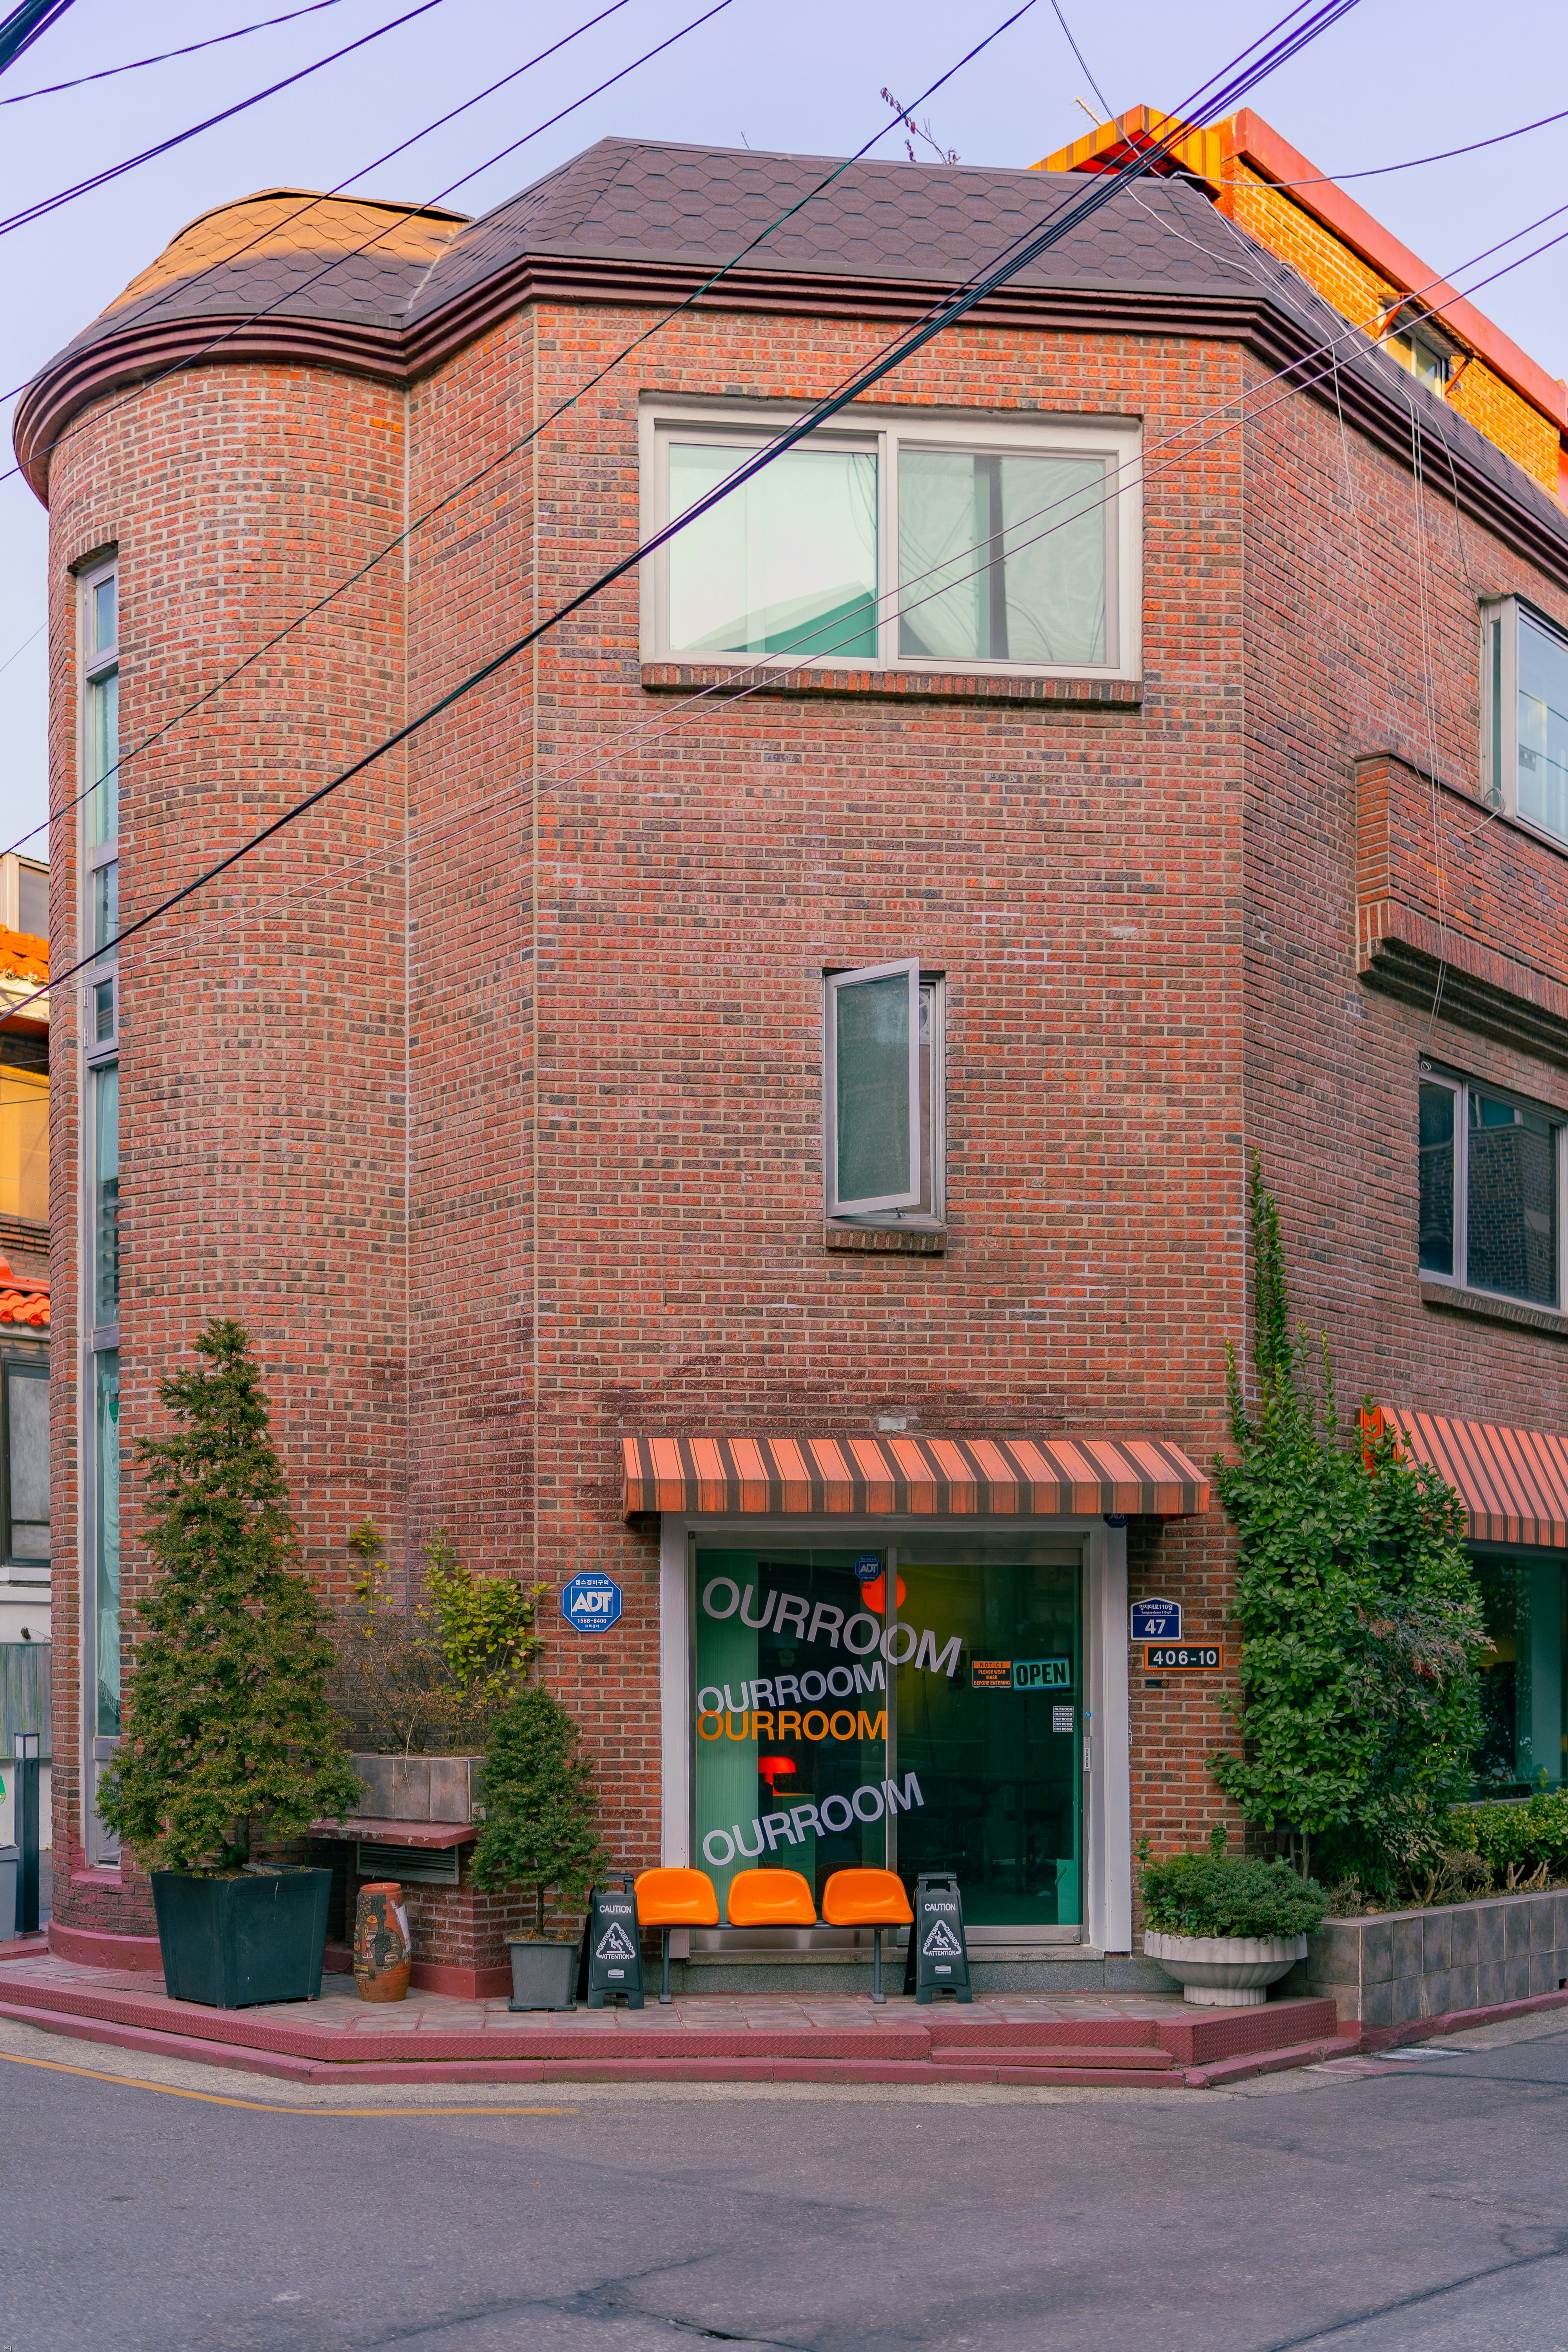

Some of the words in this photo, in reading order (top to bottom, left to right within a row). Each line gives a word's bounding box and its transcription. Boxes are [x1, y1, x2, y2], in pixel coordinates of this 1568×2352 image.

[860, 1564, 878, 1573] ADT
[572, 1592, 612, 1612] ADT
[702, 1577, 962, 1677] OURROOM
[1145, 1619, 1166, 1634] 47
[1153, 1650, 1216, 1665] 406-10
[1016, 1662, 1067, 1686] OPEN
[697, 1661, 886, 1717] OURROOM
[697, 1710, 887, 1740] OURROOM
[702, 1772, 924, 1866] OURROOM
[597, 1929, 613, 1950] CAUTION
[619, 1929, 633, 1951] CUIDADO
[924, 1926, 938, 1948] CAUTION
[944, 1926, 960, 1947] CUIDADO
